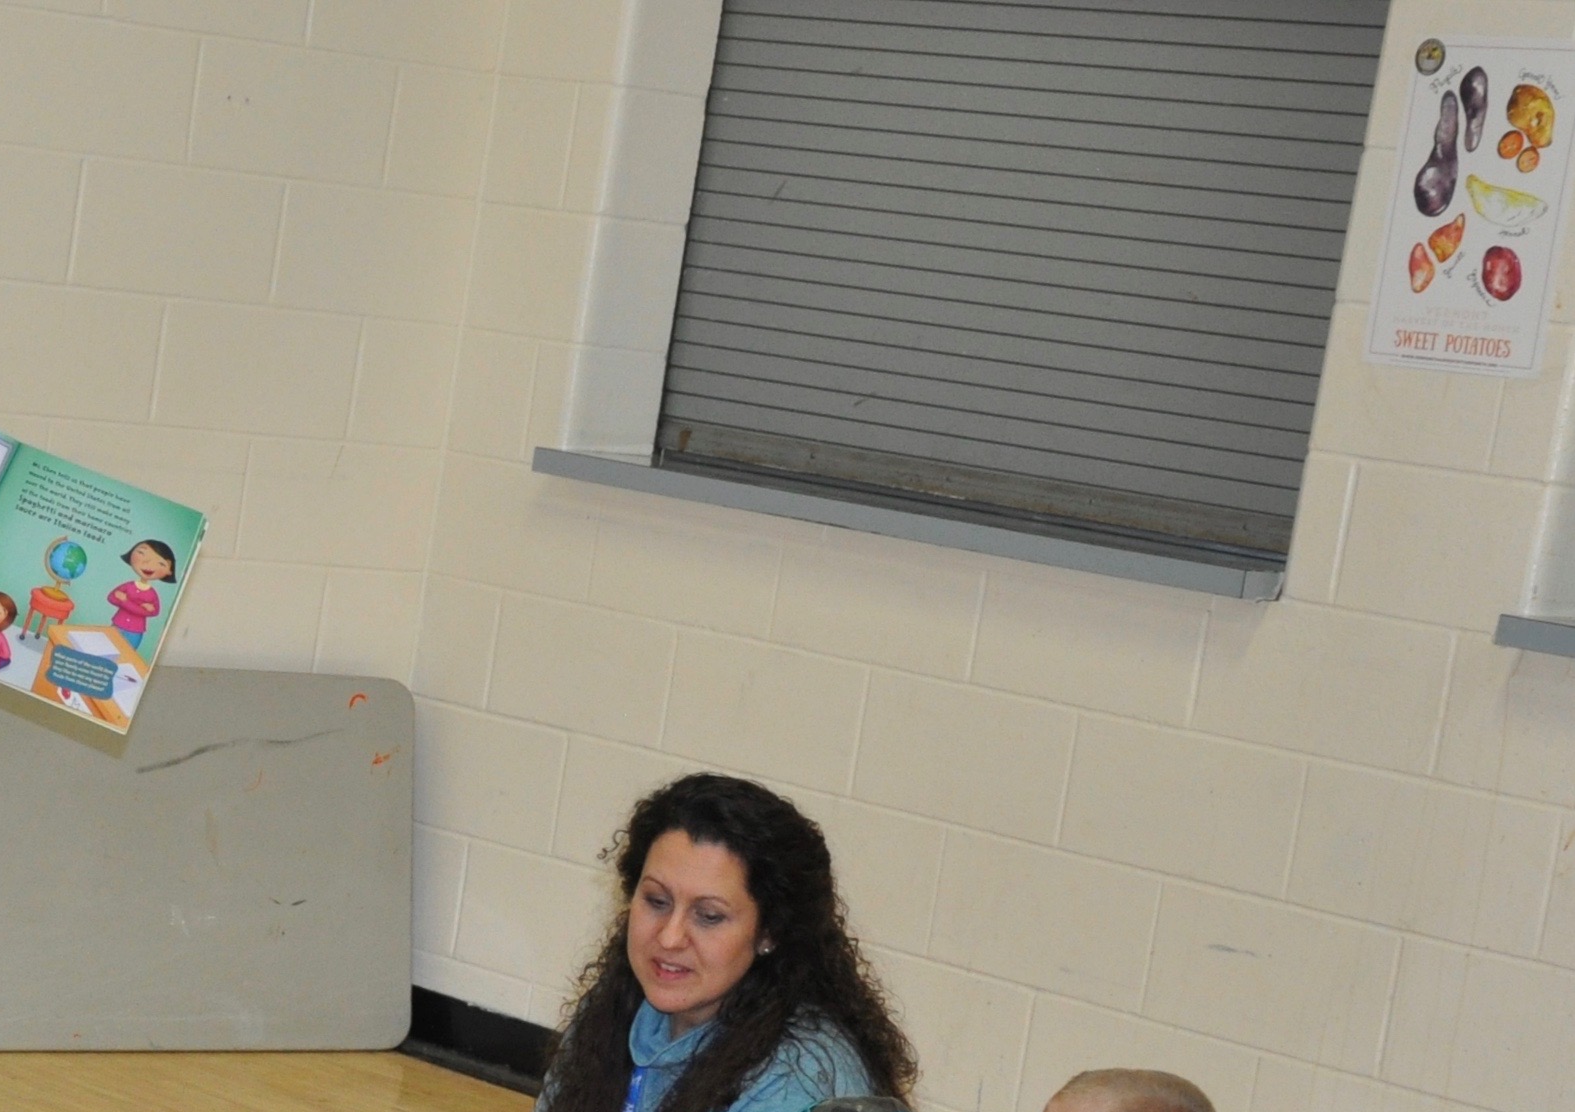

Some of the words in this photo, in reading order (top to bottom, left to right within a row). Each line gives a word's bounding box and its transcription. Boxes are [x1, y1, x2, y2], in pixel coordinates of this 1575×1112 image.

[1394, 329, 1439, 351] SWEET
[1445, 333, 1511, 359] POTATOES
[15, 504, 37, 516] sauce
[38, 514, 52, 522] are
[54, 519, 82, 534] Italian
[18, 495, 57, 516] Spaghetti
[58, 510, 74, 521] and
[75, 518, 112, 536] marinara
